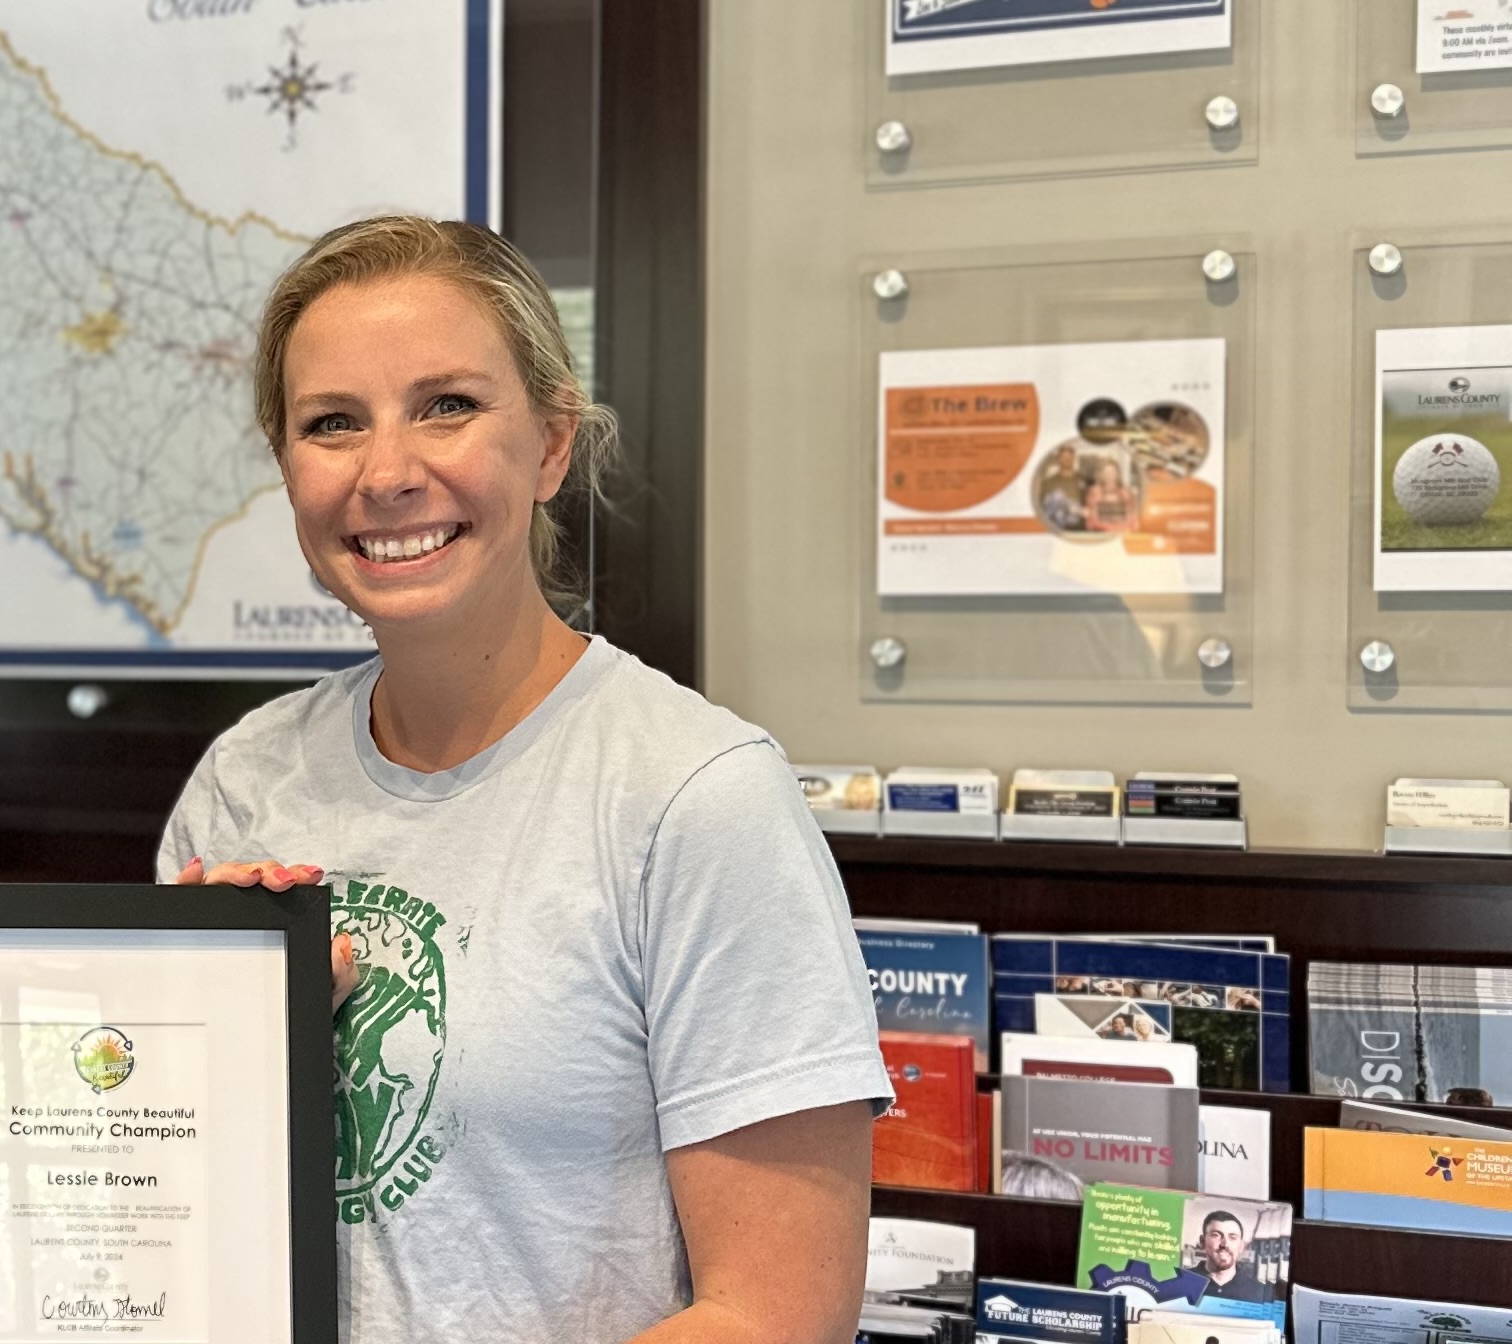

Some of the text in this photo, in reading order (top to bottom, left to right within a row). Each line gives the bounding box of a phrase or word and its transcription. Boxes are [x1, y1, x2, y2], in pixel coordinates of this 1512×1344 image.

[932, 397, 1028, 414] The Brew
[896, 940, 935, 950] Directory
[867, 968, 968, 996] COUNTY
[11, 1105, 195, 1121] Keep Laurens County Beautiful
[9, 1121, 197, 1141] Community Champion
[71, 1144, 135, 1155] PRESENTED TO
[1033, 1138, 1175, 1167] NO LIMITS
[380, 1136, 446, 1211] CLUB
[1467, 1161, 1512, 1175] MUSEU
[47, 1170, 158, 1187] Lessie Brown
[1096, 1201, 1150, 1217] opportunity
[65, 1224, 137, 1234] SECOND QUARTER
[31, 1238, 173, 1248] LAURENS SOUTH CAROLINA
[79, 1253, 124, 1262] July 2024
[891, 1248, 954, 1266] FOUNDATION
[988, 1310, 1029, 1323] FUTURE
[1031, 1315, 1103, 1331] SCHOLARSHIP
[1032, 1308, 1067, 1319] LAURENS
[1068, 1312, 1102, 1322] COUNTY
